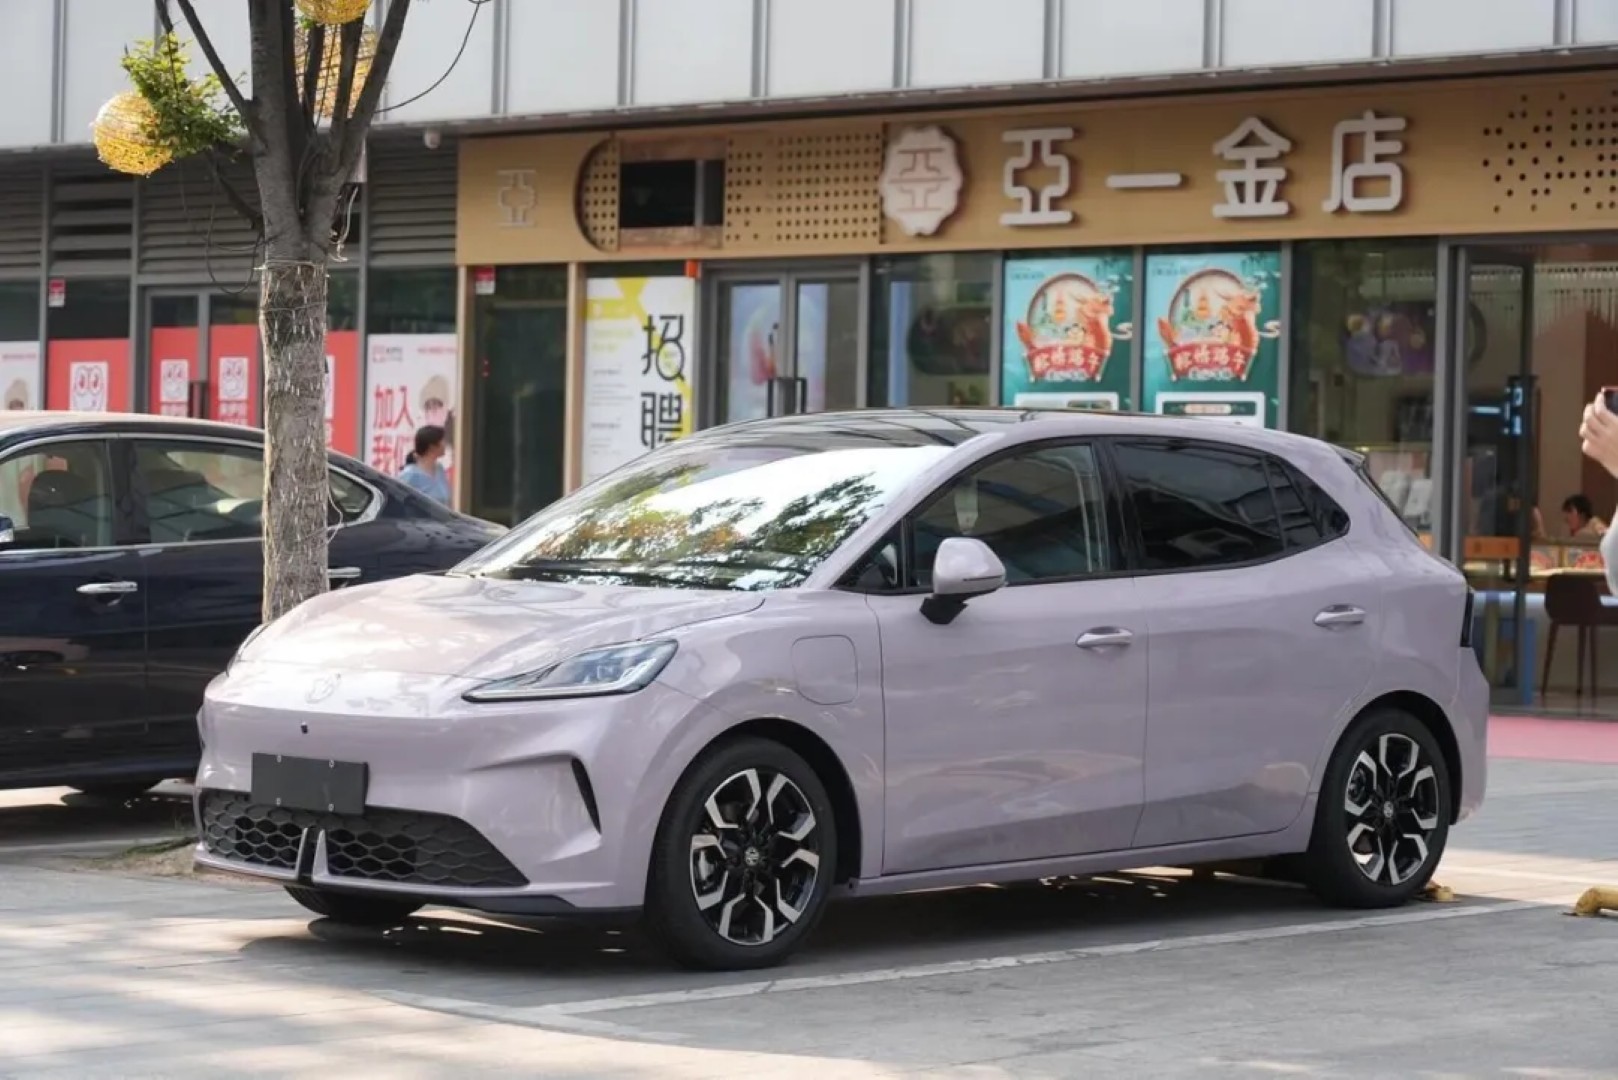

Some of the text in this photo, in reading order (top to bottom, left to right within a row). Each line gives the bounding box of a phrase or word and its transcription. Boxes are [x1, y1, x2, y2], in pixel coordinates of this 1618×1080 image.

[999, 110, 1406, 227] 亞一金店
[373, 384, 415, 429] 加入
[640, 313, 685, 450] 招聘
